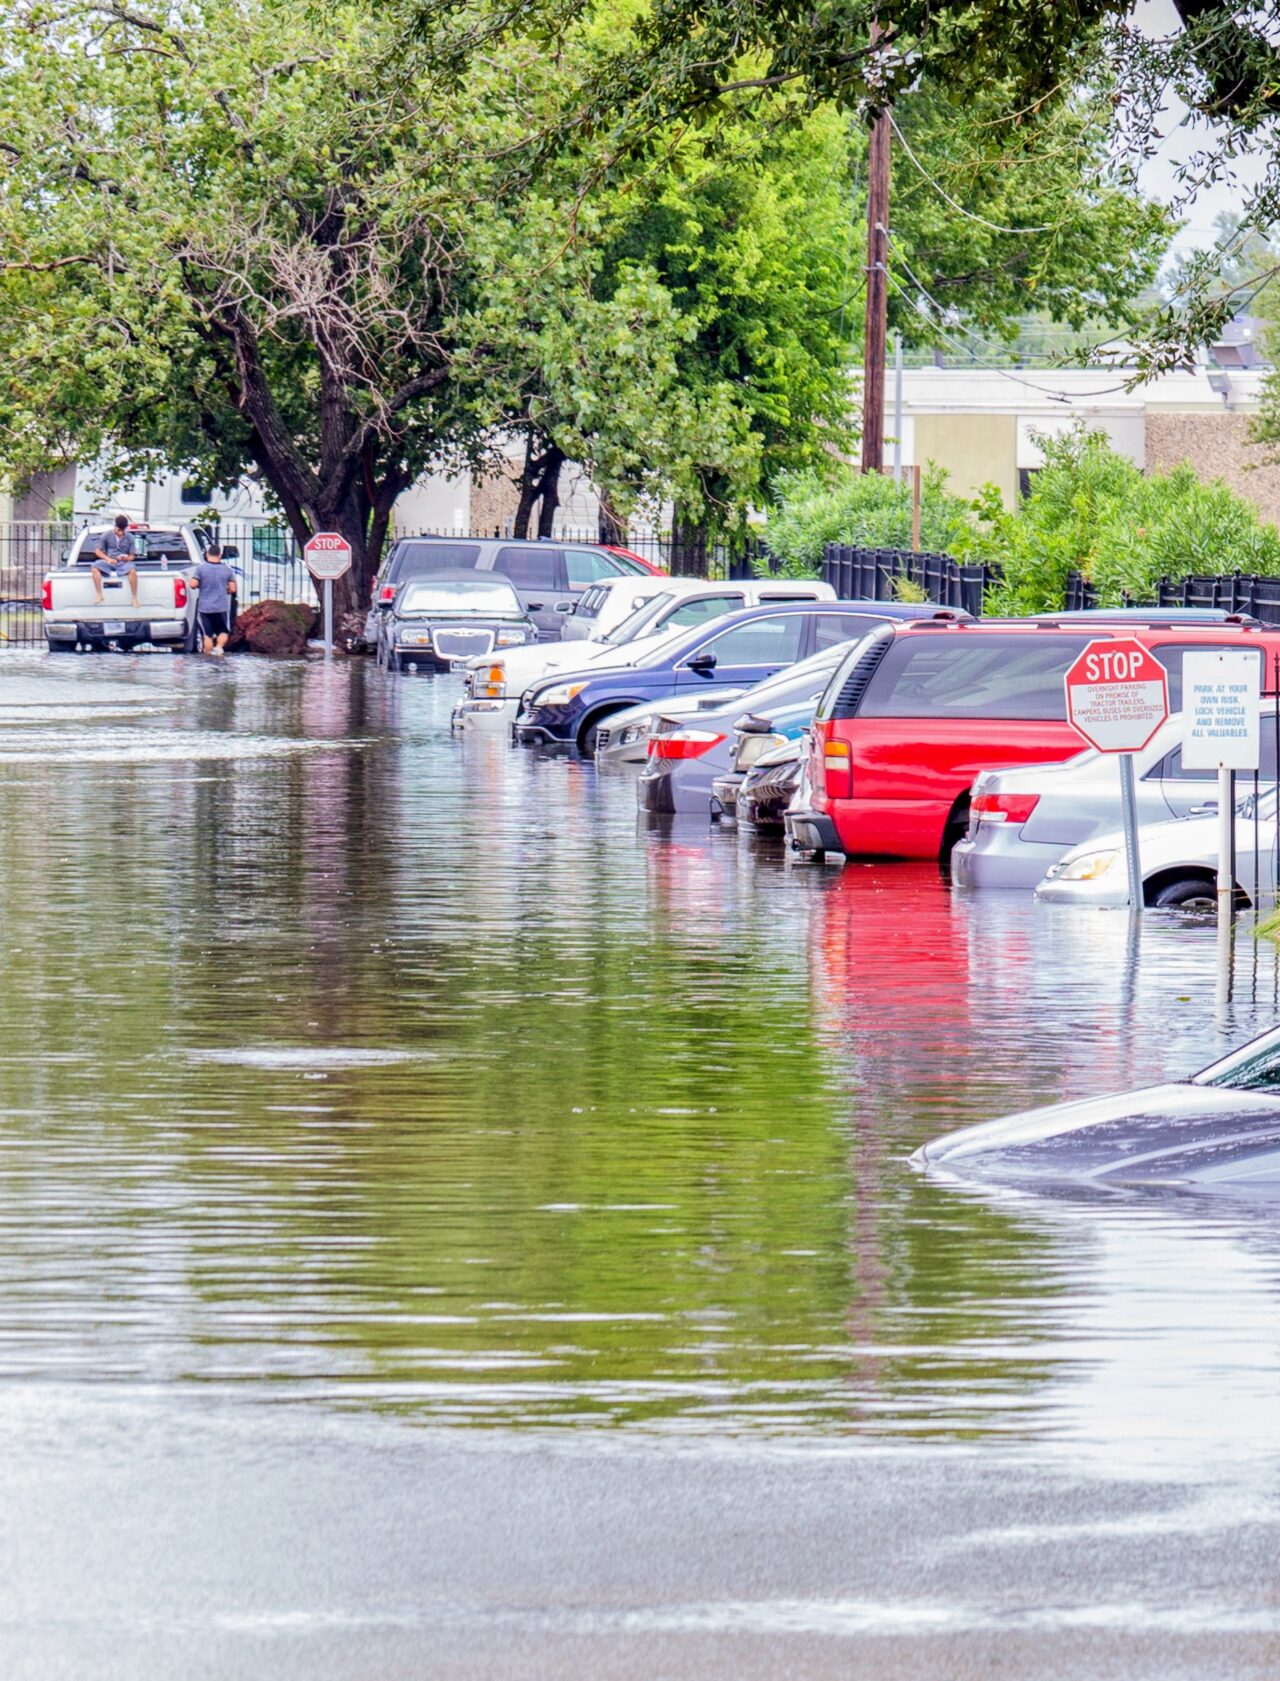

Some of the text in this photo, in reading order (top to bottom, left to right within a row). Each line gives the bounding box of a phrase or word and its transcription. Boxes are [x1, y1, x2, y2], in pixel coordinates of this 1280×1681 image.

[314, 538, 341, 549] STOP
[1086, 652, 1143, 681] STOP
[1087, 685, 1119, 693] OVERNIGHT
[1193, 685, 1213, 693] PARK
[1105, 691, 1129, 699] PREMISE
[1200, 696, 1218, 704] OWN
[1195, 706, 1246, 715] LOCK VEHICLE
[1084, 714, 1112, 723] VEHICLES
[1196, 717, 1245, 726] AND REMOVE
[1191, 728, 1204, 737] ALL
